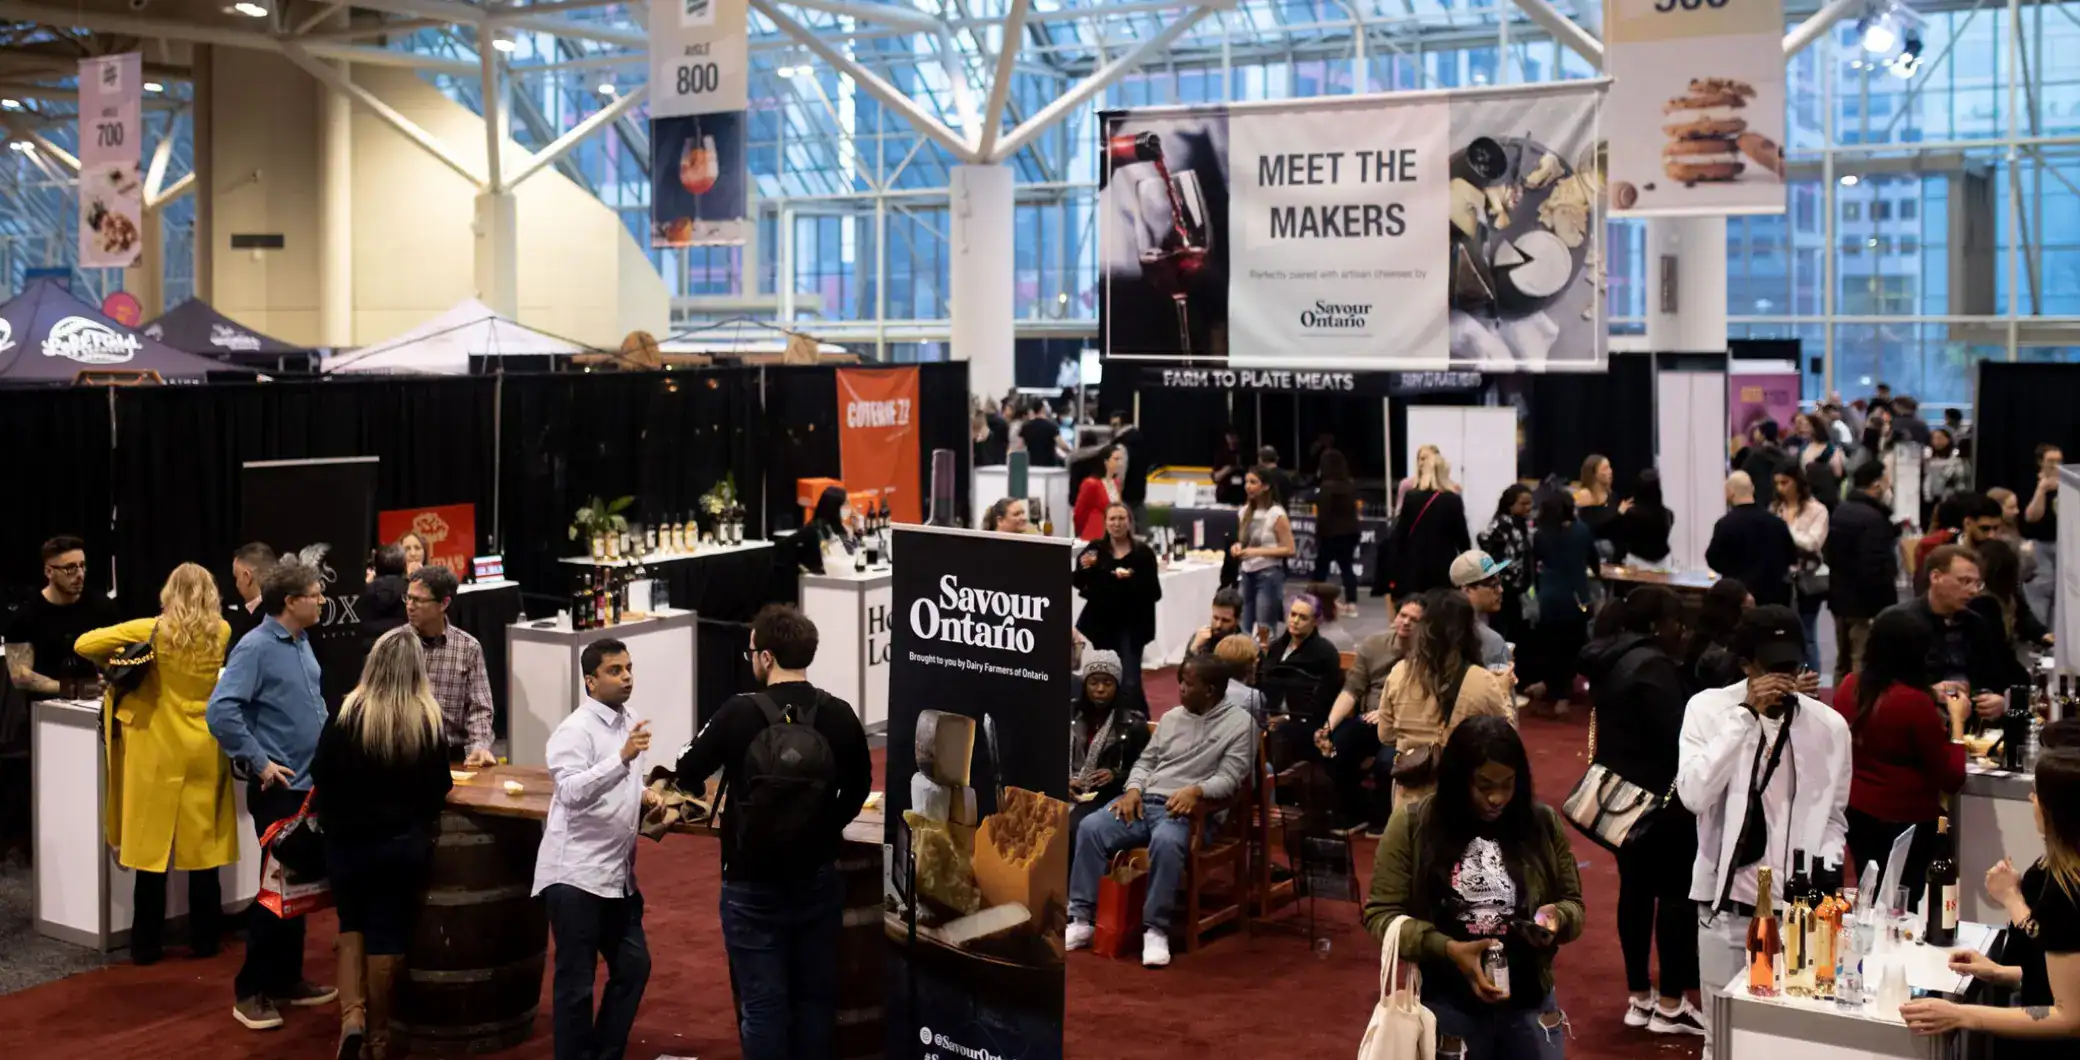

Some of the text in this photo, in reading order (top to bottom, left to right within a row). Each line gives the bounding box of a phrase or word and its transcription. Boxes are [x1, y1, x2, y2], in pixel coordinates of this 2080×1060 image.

[677, 62, 719, 95] 800
[96, 121, 124, 147] 700
[1258, 149, 1417, 187] MEET THE
[1270, 203, 1406, 238] MAKERS
[1300, 311, 1365, 328] Ontario
[1315, 300, 1372, 315] Savour
[1163, 370, 1355, 391] FARM TO PLATE MEATS
[939, 574, 1050, 622] Savour
[909, 597, 1035, 654] Ontario
[909, 651, 1049, 682] Brought to you by Dairy Farmers of Ontario
